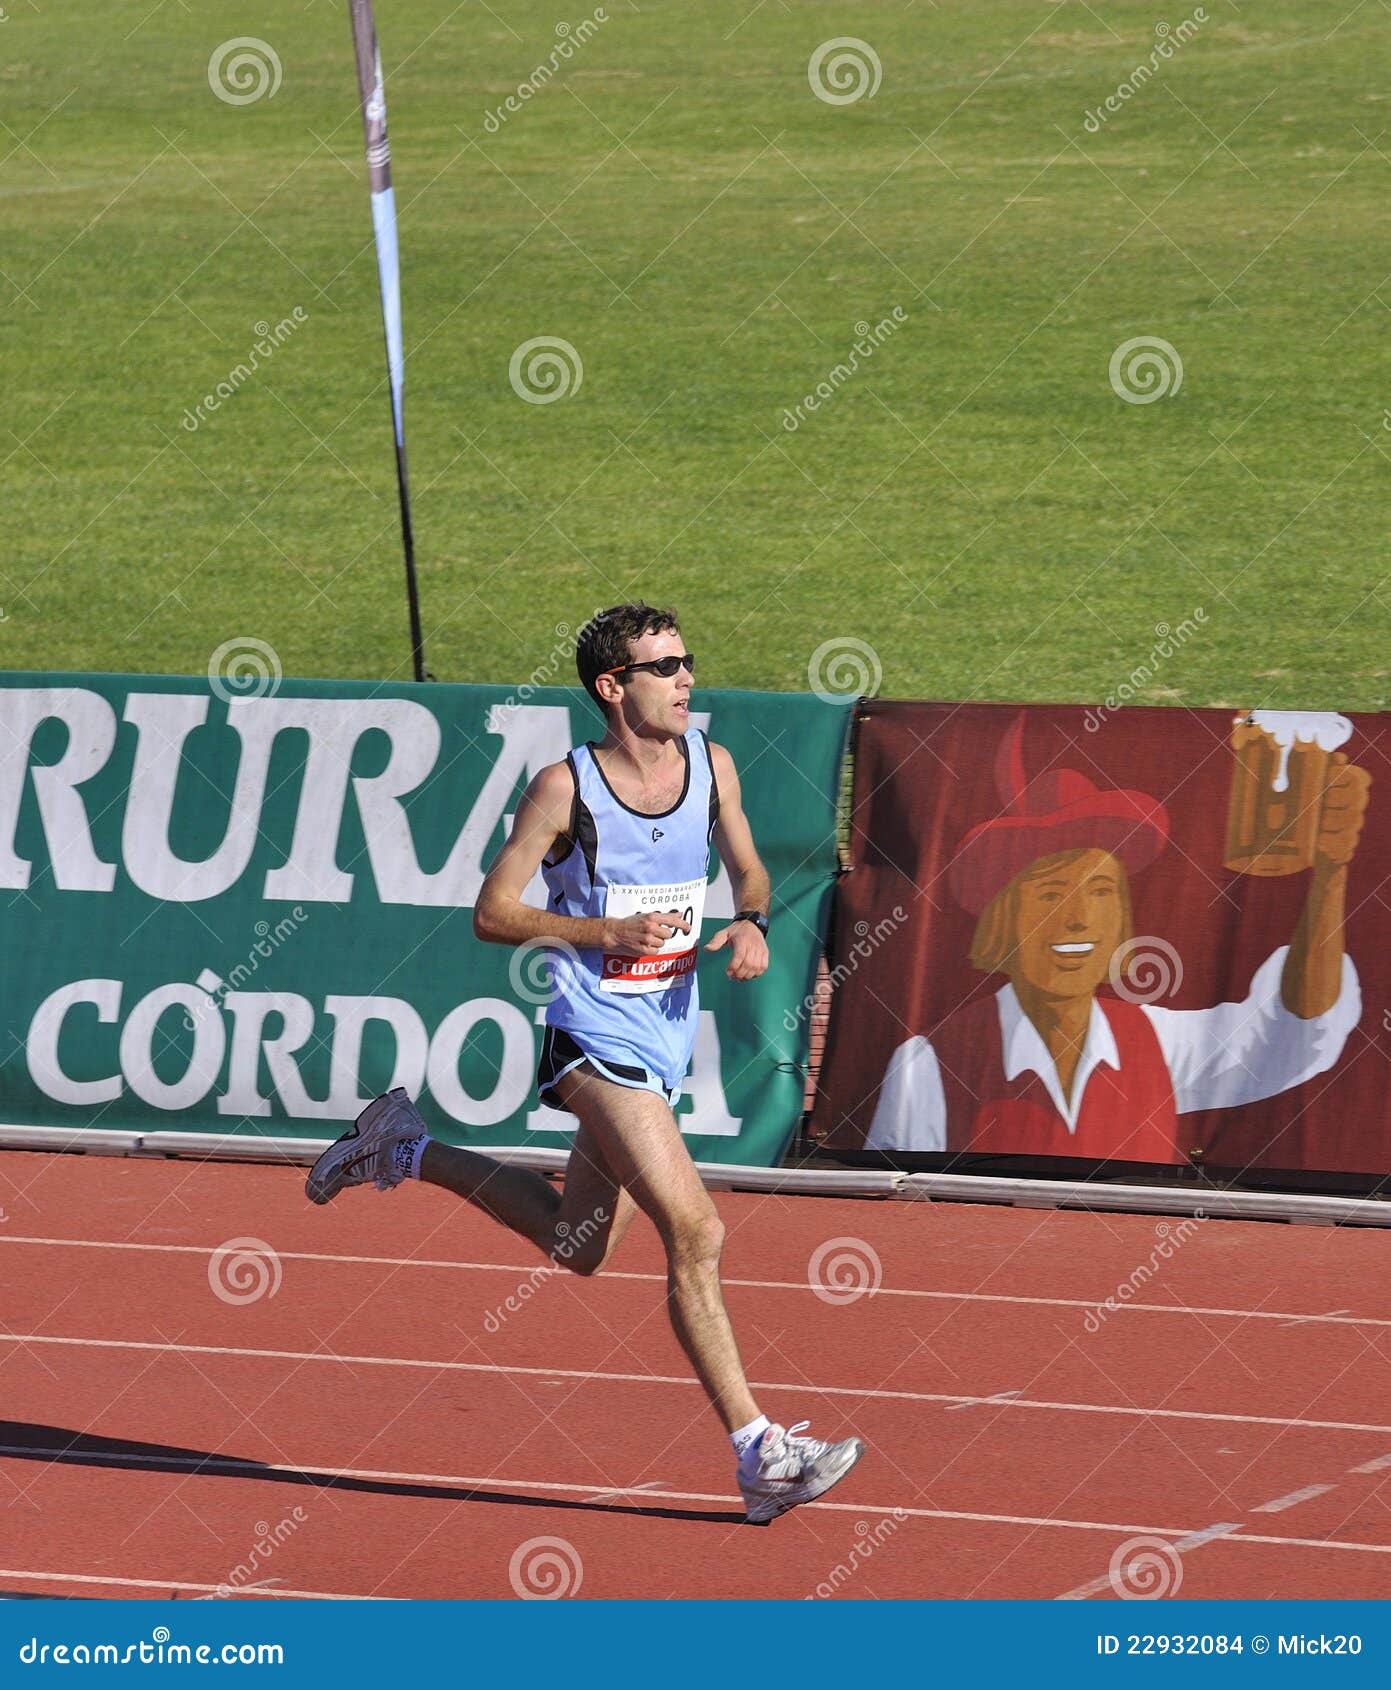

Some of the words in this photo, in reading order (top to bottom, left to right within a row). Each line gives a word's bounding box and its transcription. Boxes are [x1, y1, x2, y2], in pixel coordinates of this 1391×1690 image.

[0, 687, 735, 918] RURA
[606, 954, 695, 976] Cruzcampo
[26, 968, 743, 1136] CÓRDOA
